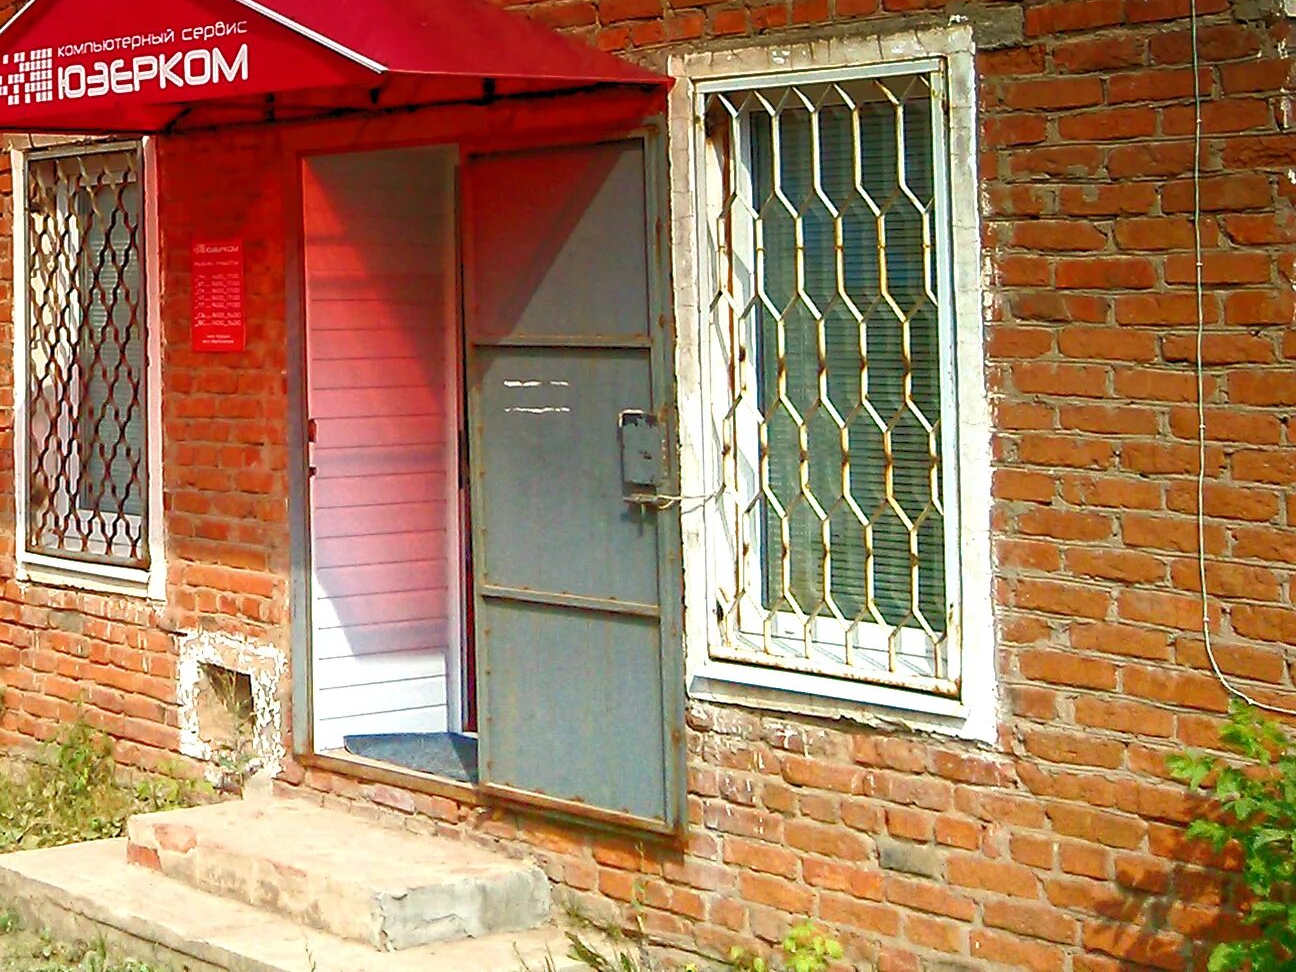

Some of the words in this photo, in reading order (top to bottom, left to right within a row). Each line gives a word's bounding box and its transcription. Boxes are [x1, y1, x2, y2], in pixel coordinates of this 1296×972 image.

[57, 28, 175, 58] компьютерный
[181, 20, 248, 42] сервис
[57, 43, 249, 100] ЮЗЕРКОМ
